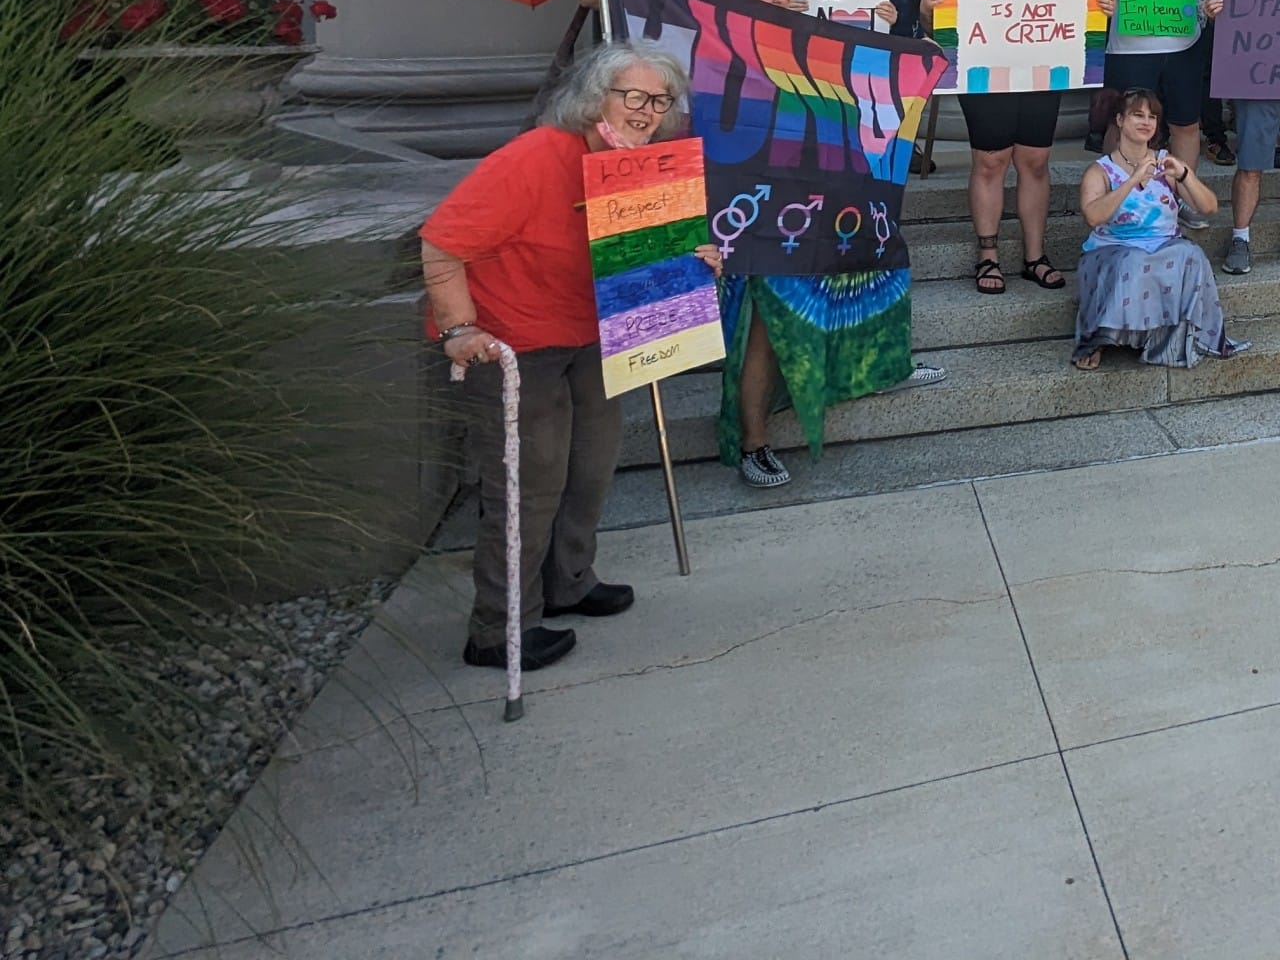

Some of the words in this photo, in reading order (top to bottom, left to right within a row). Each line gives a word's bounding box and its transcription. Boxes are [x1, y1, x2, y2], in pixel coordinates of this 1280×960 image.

[991, 3, 1013, 17] IS
[1022, 3, 1056, 19] NOT
[1153, 2, 1182, 21] being
[969, 22, 987, 45] A
[1005, 22, 1075, 44] CRIME
[601, 154, 675, 184] LOVE
[607, 192, 670, 224] Respect
